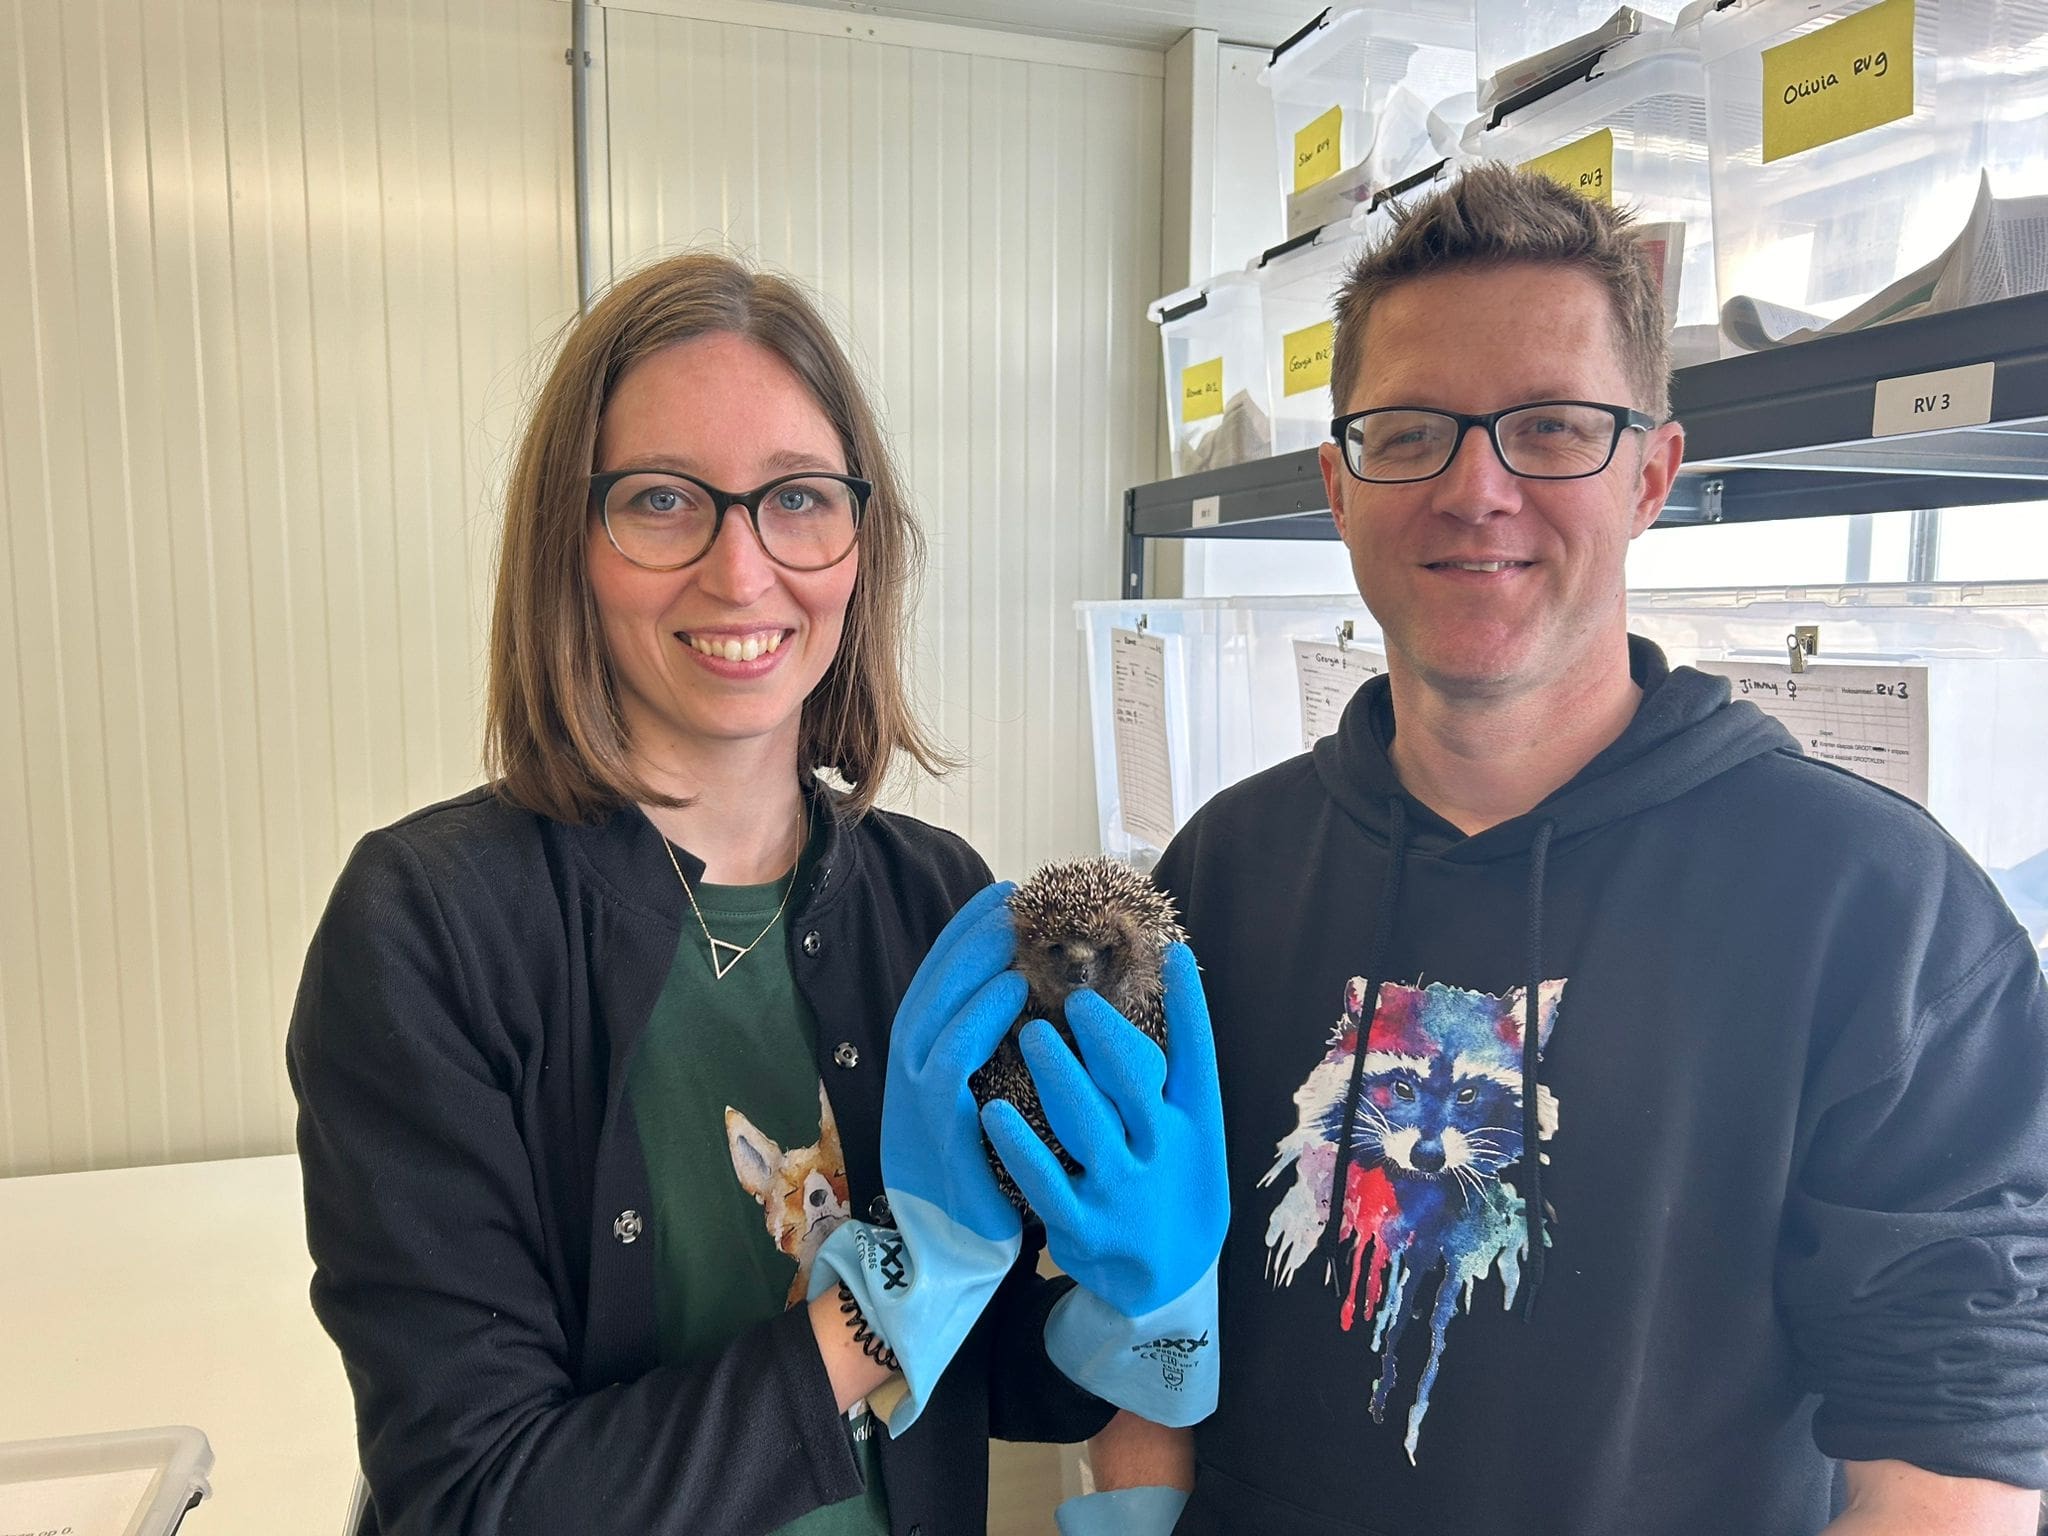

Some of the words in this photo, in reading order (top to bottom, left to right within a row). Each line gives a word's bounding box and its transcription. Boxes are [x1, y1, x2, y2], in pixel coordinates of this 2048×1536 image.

[1783, 73, 1839, 105] Olivia
[1914, 395, 1937, 413] RV
[1941, 393, 1950, 410] 3
[1315, 652, 1340, 667] Georgia
[1739, 678, 1779, 696] Jimmy
